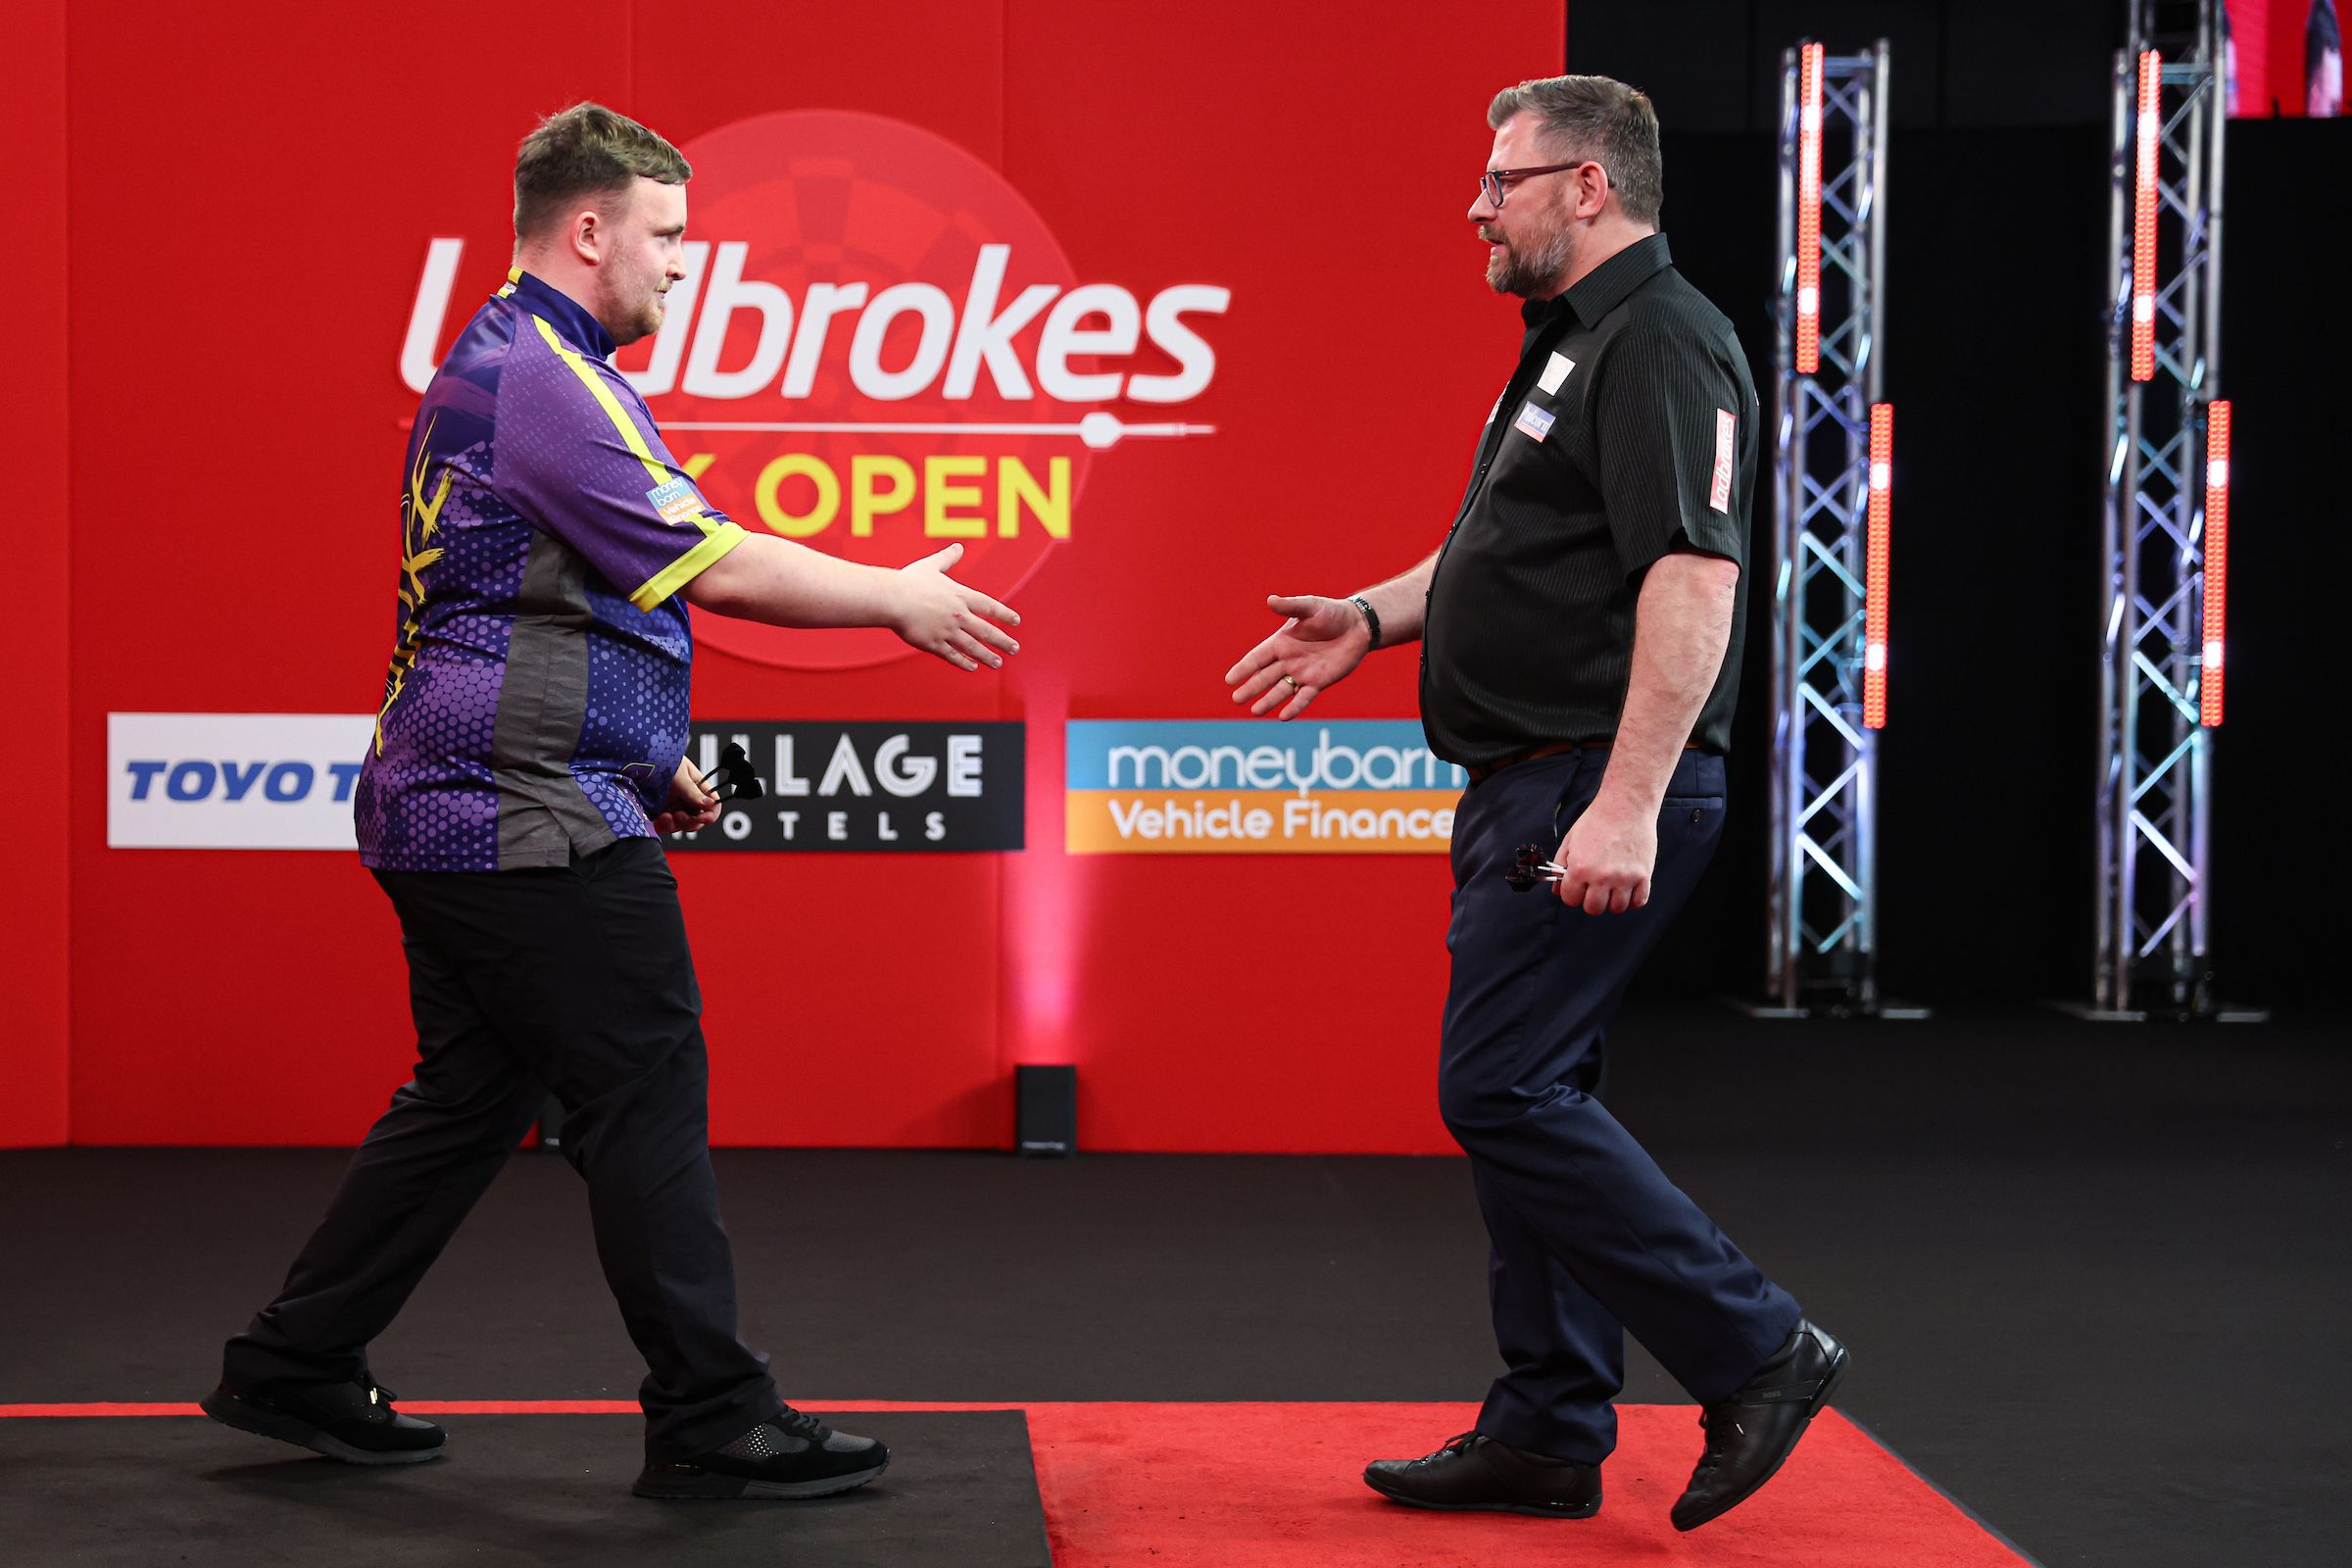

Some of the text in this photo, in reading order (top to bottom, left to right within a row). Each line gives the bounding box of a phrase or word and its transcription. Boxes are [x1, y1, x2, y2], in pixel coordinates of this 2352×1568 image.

[399, 237, 1232, 403] Ldbrokes
[651, 478, 684, 497] money
[755, 454, 1071, 540] OPEN
[126, 760, 316, 803] TOYO
[687, 734, 983, 797] ILAGE
[1107, 729, 1462, 798] moneybarn
[671, 810, 947, 841] OTELS
[1107, 799, 1456, 839] Vehicle Finance
